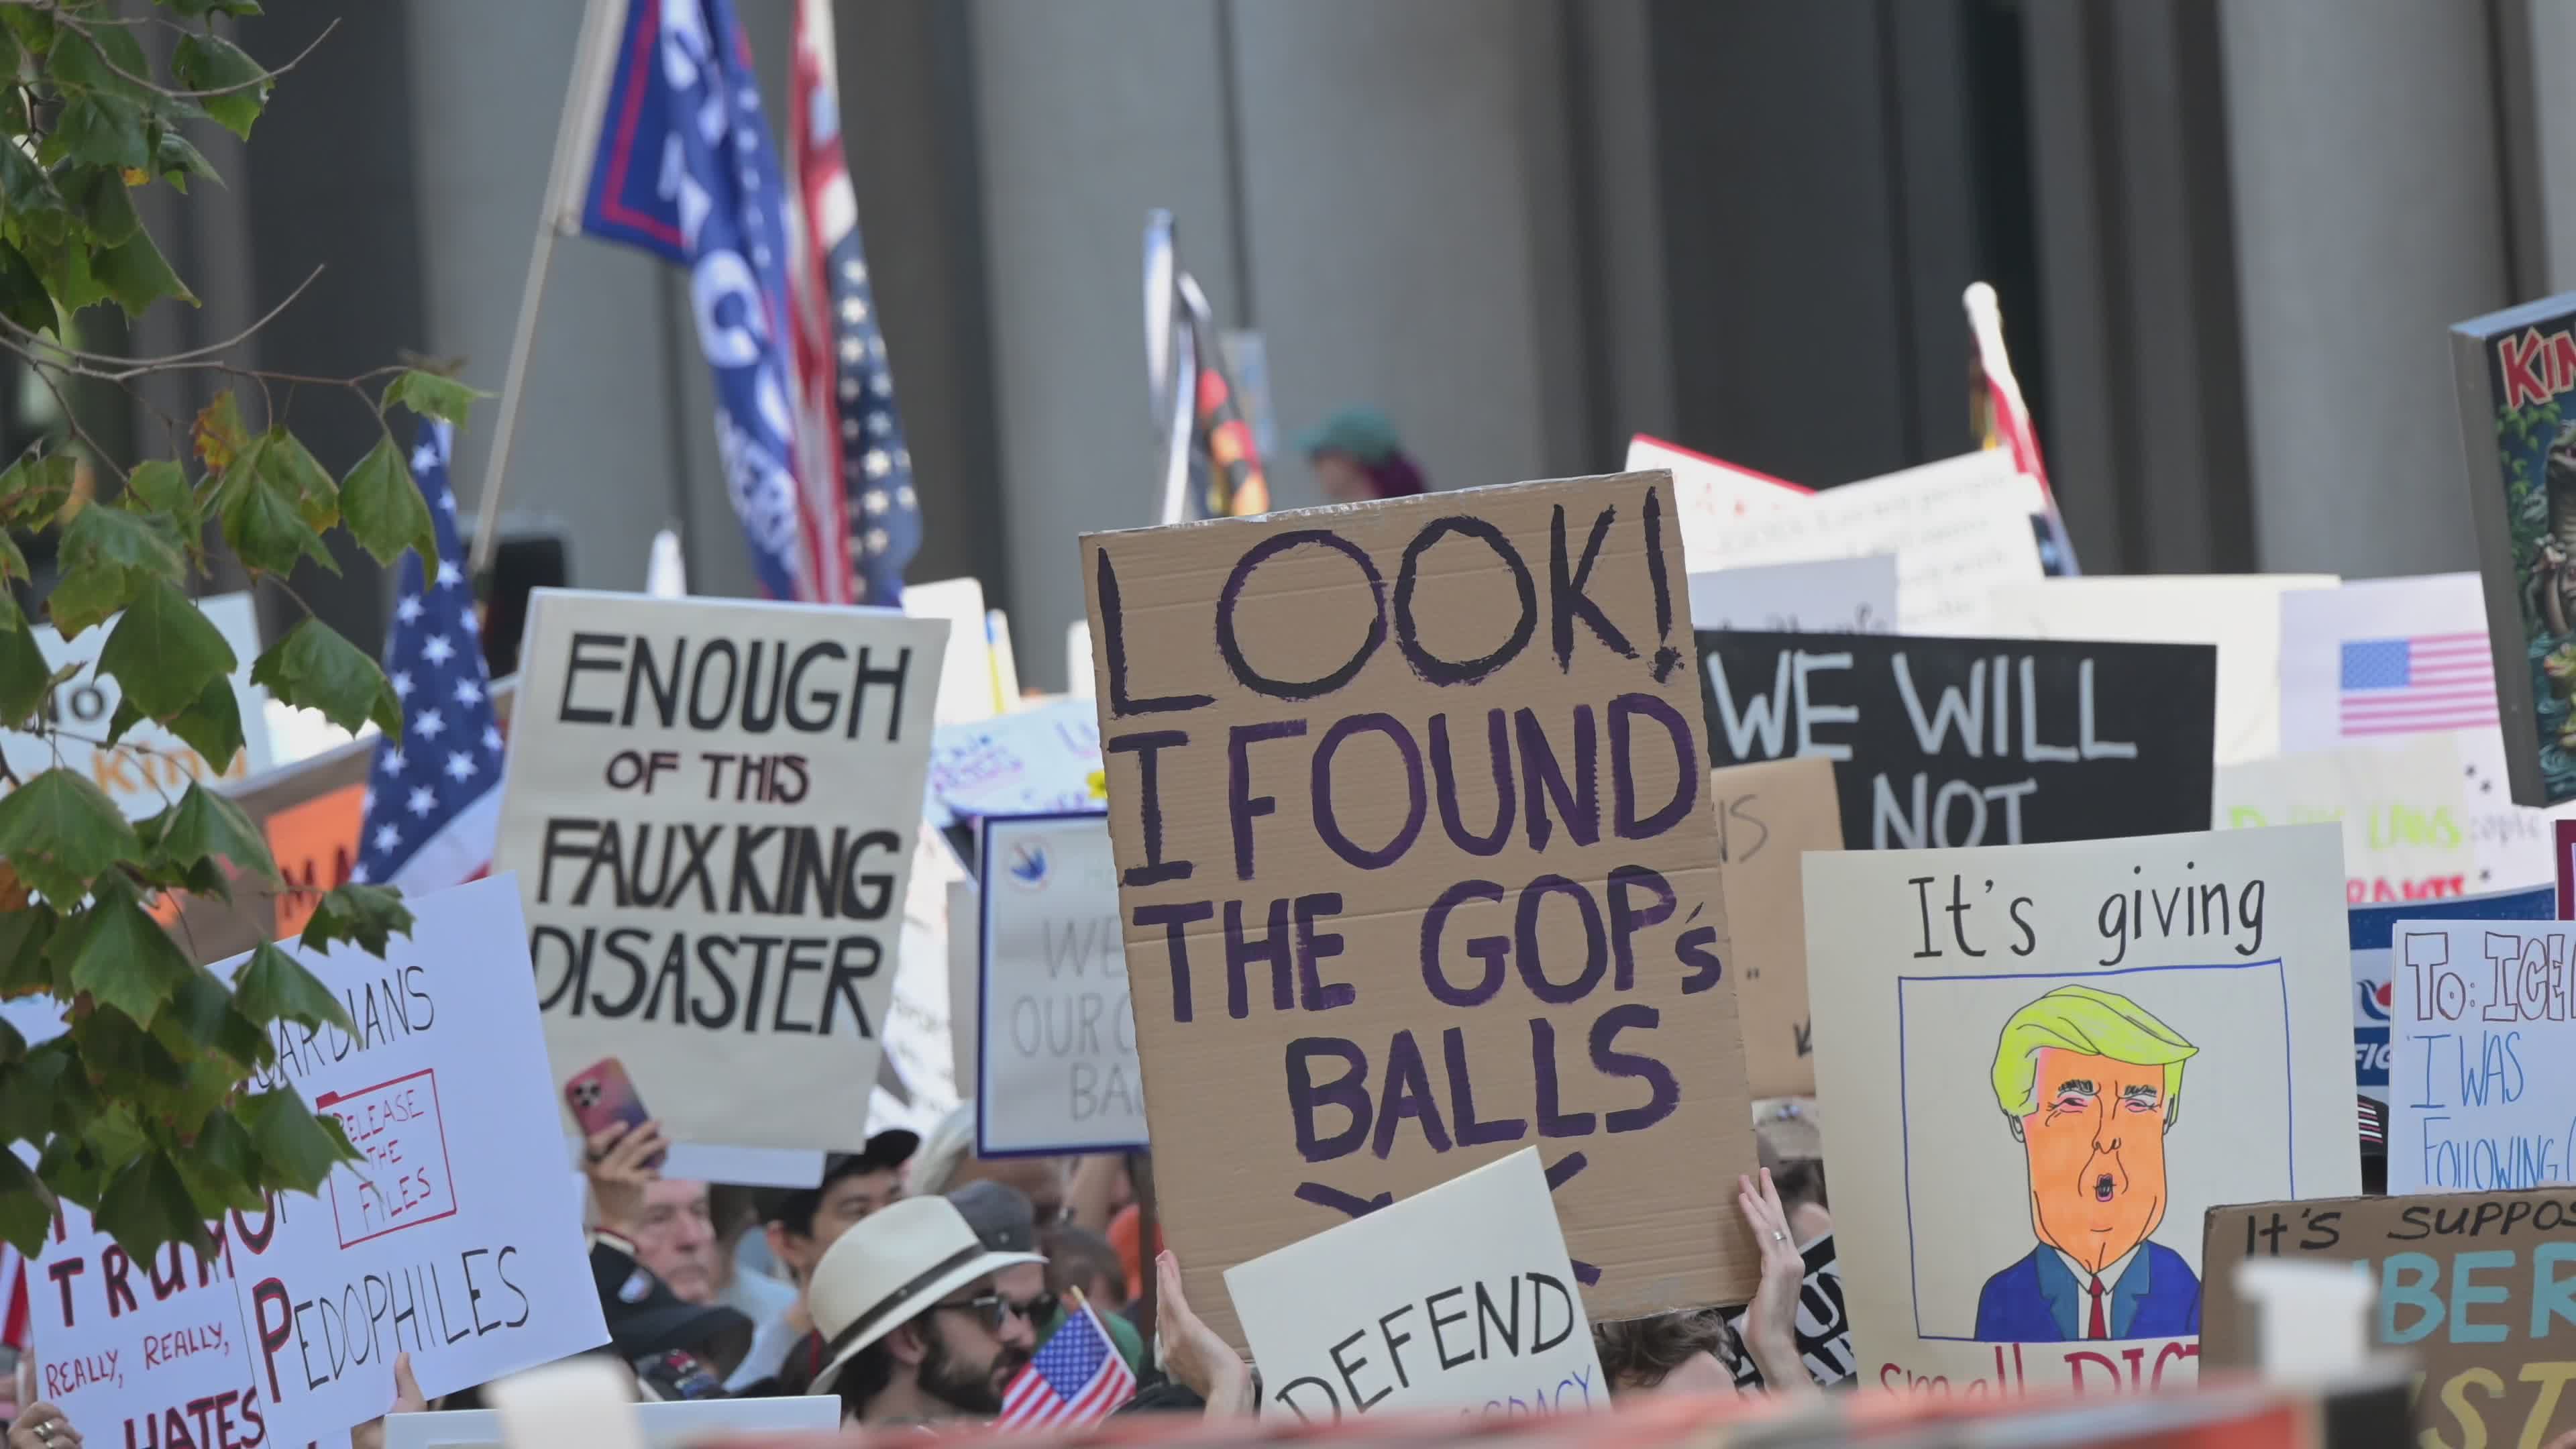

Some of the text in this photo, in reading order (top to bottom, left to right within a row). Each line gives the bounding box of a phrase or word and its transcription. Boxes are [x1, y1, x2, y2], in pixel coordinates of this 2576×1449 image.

[1097, 486, 1685, 719] LOOK!
[559, 633, 912, 742] ENOUGH
[1707, 649, 2137, 762] WE WILL
[606, 750, 810, 805] OF THIS
[1109, 692, 1699, 887] I FOUND
[1872, 771, 2037, 849] NOT
[1132, 892, 1356, 1023] THE
[1908, 861, 2265, 966] It's giving
[533, 926, 885, 1038] DISASTER
[1010, 991, 1104, 1059] OUR
[2483, 931, 2565, 1022] ICE
[1071, 1062, 1142, 1122] BA
[1285, 1004, 1680, 1163] BALLS
[2459, 1030, 2524, 1107] WAS
[366, 1139, 402, 1170] THE
[45, 1321, 230, 1400] REALLY, REALLY,
[252, 1245, 530, 1403] PEDOPHILES
[1275, 1272, 1574, 1429] DEFEND
